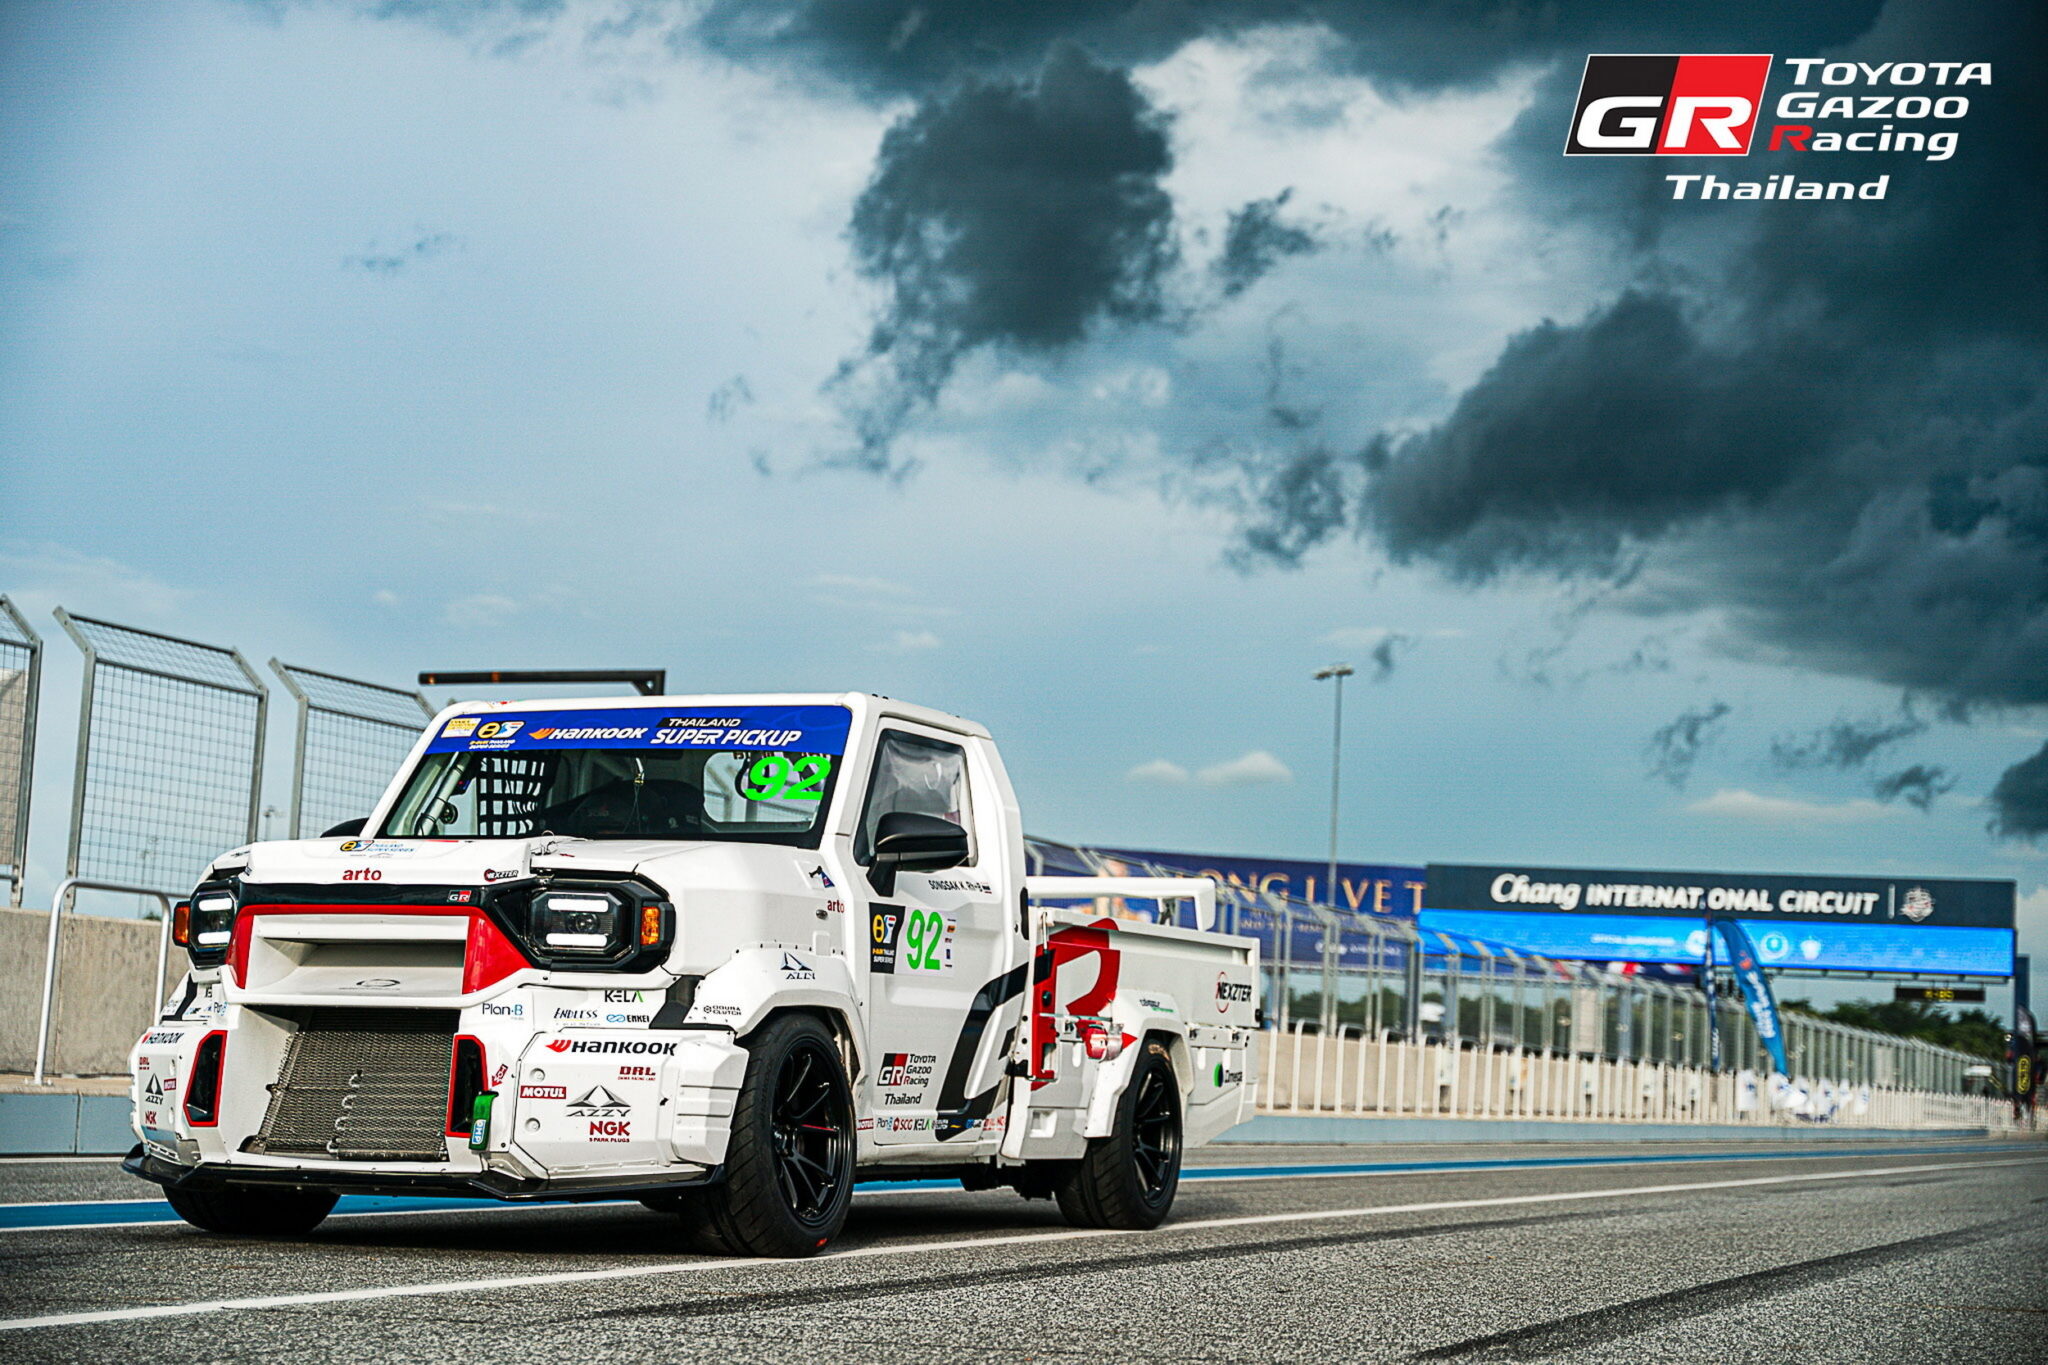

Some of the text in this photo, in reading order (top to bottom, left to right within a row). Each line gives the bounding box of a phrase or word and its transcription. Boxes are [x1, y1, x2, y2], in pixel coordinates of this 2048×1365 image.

[668, 718, 741, 727] THAILAND
[650, 729, 802, 746] SUPER PICKUP
[744, 756, 832, 800] 92
[342, 867, 382, 881] arto
[1490, 873, 1880, 916] Chang INTERNATONAL CIRCUIT
[827, 899, 845, 913] arto
[906, 909, 944, 971] 92
[1217, 981, 1252, 1001] NEXZTER
[553, 1007, 598, 1019] ENDLESS
[909, 1054, 936, 1064] TOYOTA
[906, 1064, 932, 1074] GAZOO
[878, 1065, 905, 1086] GR
[903, 1075, 929, 1087] Racing
[521, 1087, 566, 1098] MOTUL
[145, 1095, 164, 1105] AZZY
[884, 1093, 922, 1105] Thailand
[566, 1109, 632, 1117] AZZY
[589, 1121, 631, 1136] NGK
[900, 1119, 914, 1131] SCG
